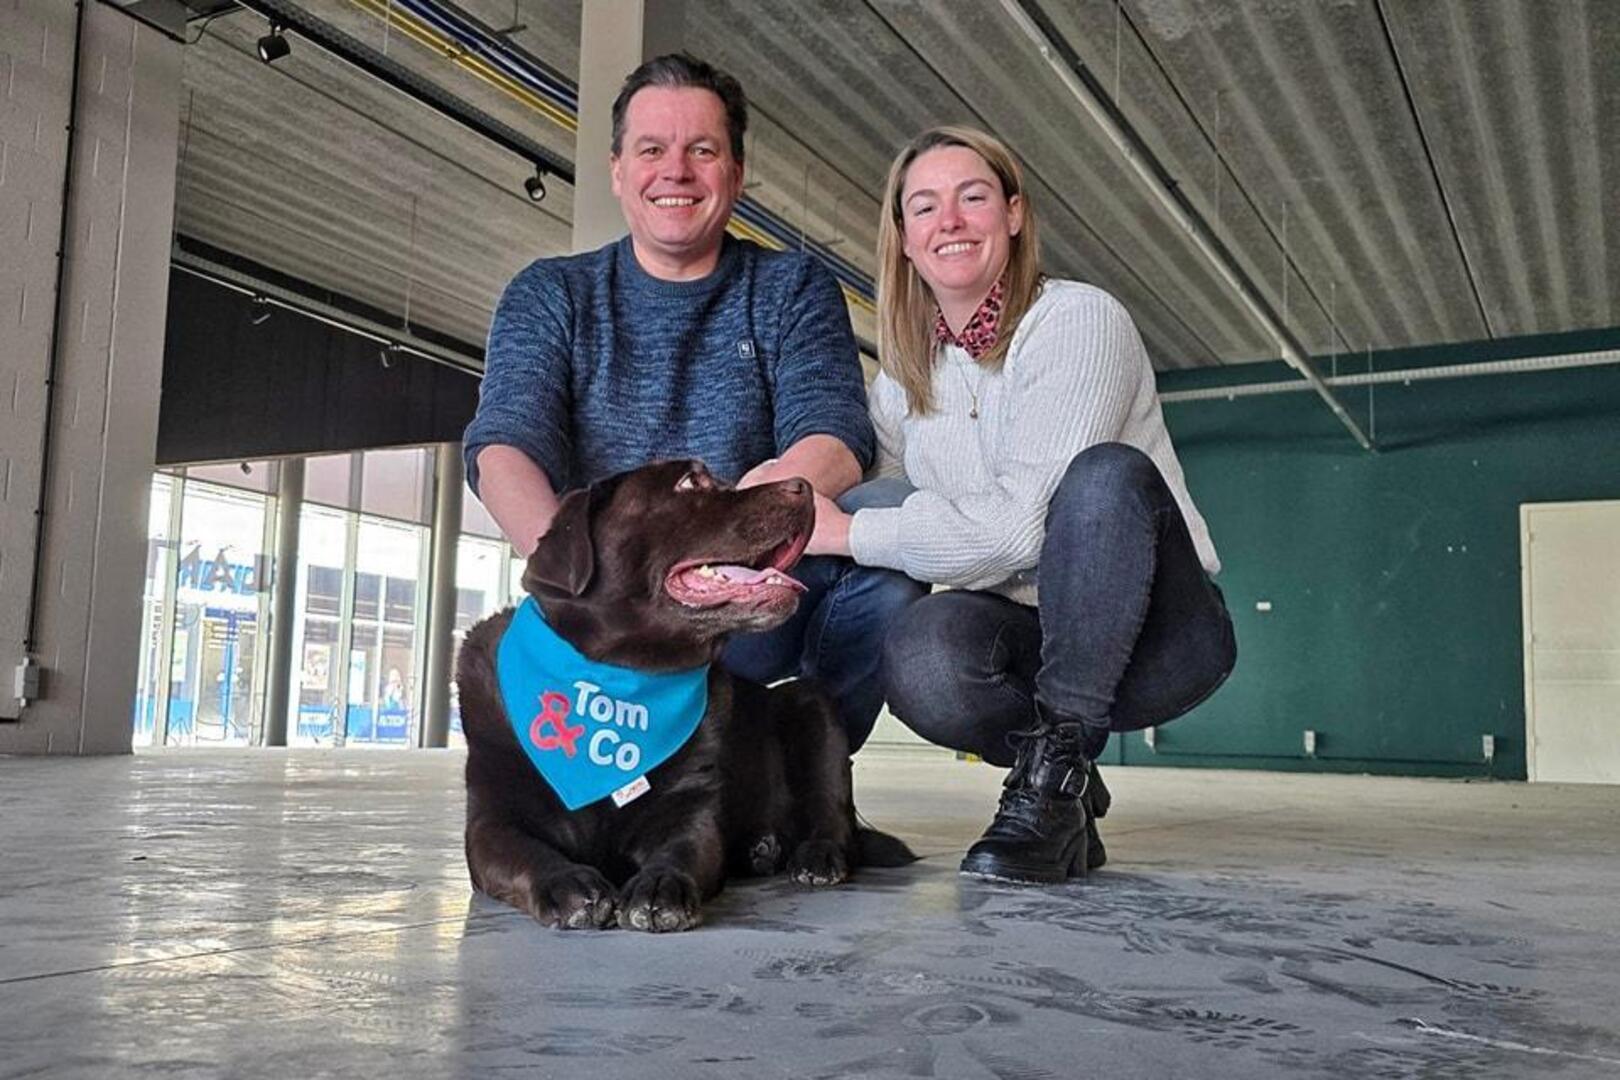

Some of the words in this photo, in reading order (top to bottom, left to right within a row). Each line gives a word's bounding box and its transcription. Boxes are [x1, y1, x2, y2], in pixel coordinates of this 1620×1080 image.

[528, 690, 586, 758] &
[588, 728, 641, 772] Co
[573, 681, 649, 731] Tom
